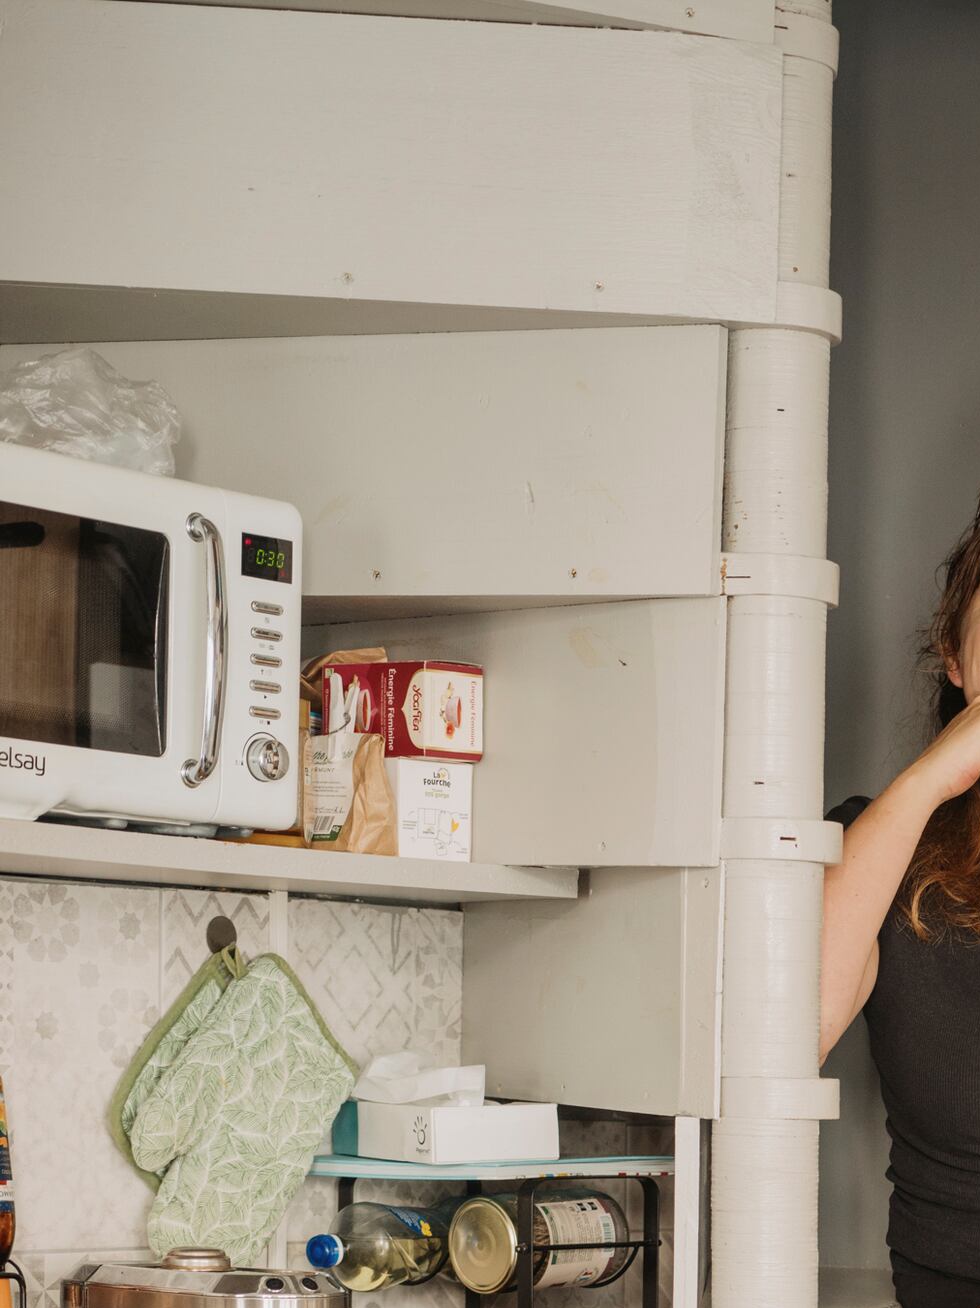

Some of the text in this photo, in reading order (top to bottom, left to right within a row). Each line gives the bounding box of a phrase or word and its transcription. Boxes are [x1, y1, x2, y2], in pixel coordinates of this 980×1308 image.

[256, 549, 285, 569] 0:30
[387, 668, 397, 751] Énergie Féminine
[433, 771, 441, 779] La
